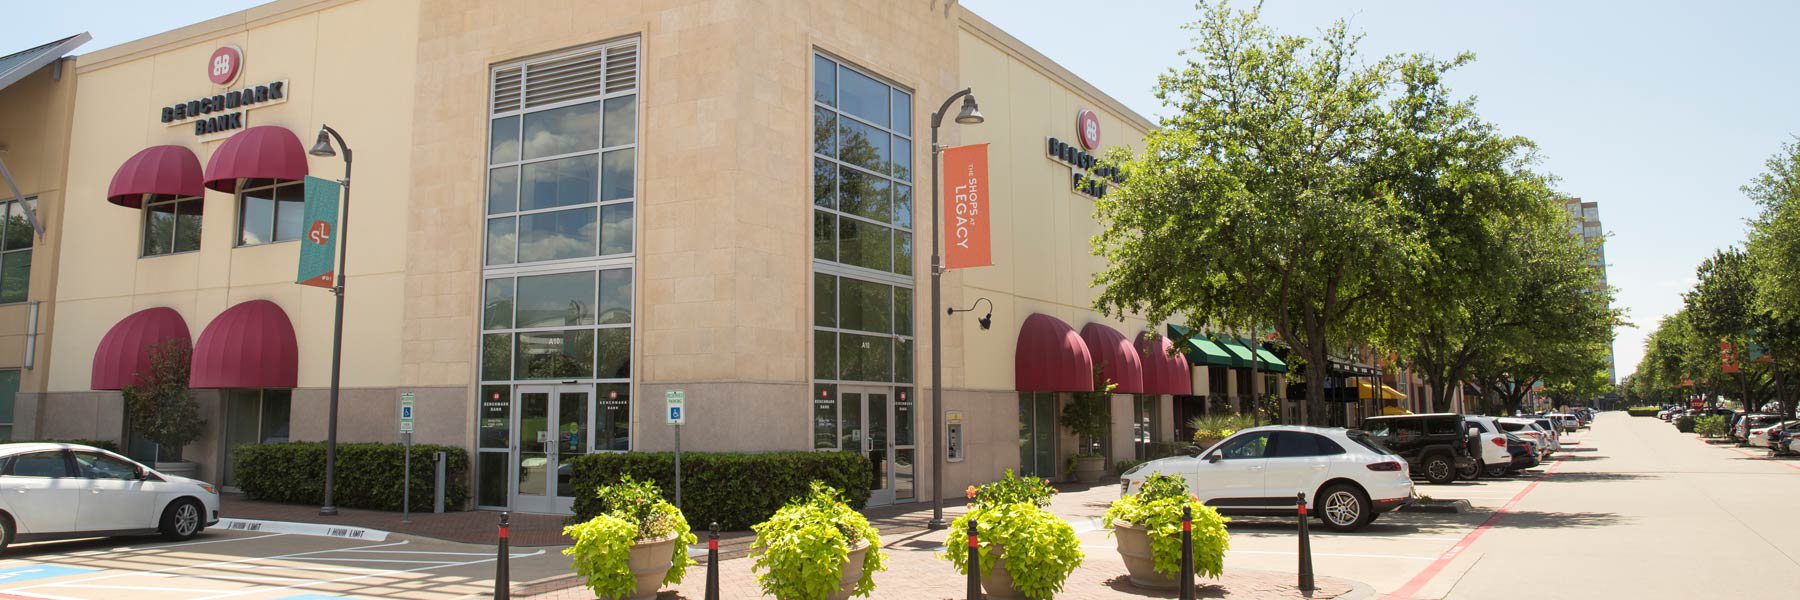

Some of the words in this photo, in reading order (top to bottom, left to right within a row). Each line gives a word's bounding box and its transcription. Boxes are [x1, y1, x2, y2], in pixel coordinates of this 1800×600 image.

[161, 81, 284, 123] BENCHMARK
[195, 112, 241, 136] BANK
[1048, 137, 1127, 184] BENCH
[968, 177, 978, 216] SHOPS
[955, 184, 969, 249] LEGACY
[969, 218, 975, 226] AT
[332, 528, 348, 536] HOUR
[349, 529, 365, 538] LIMIT
